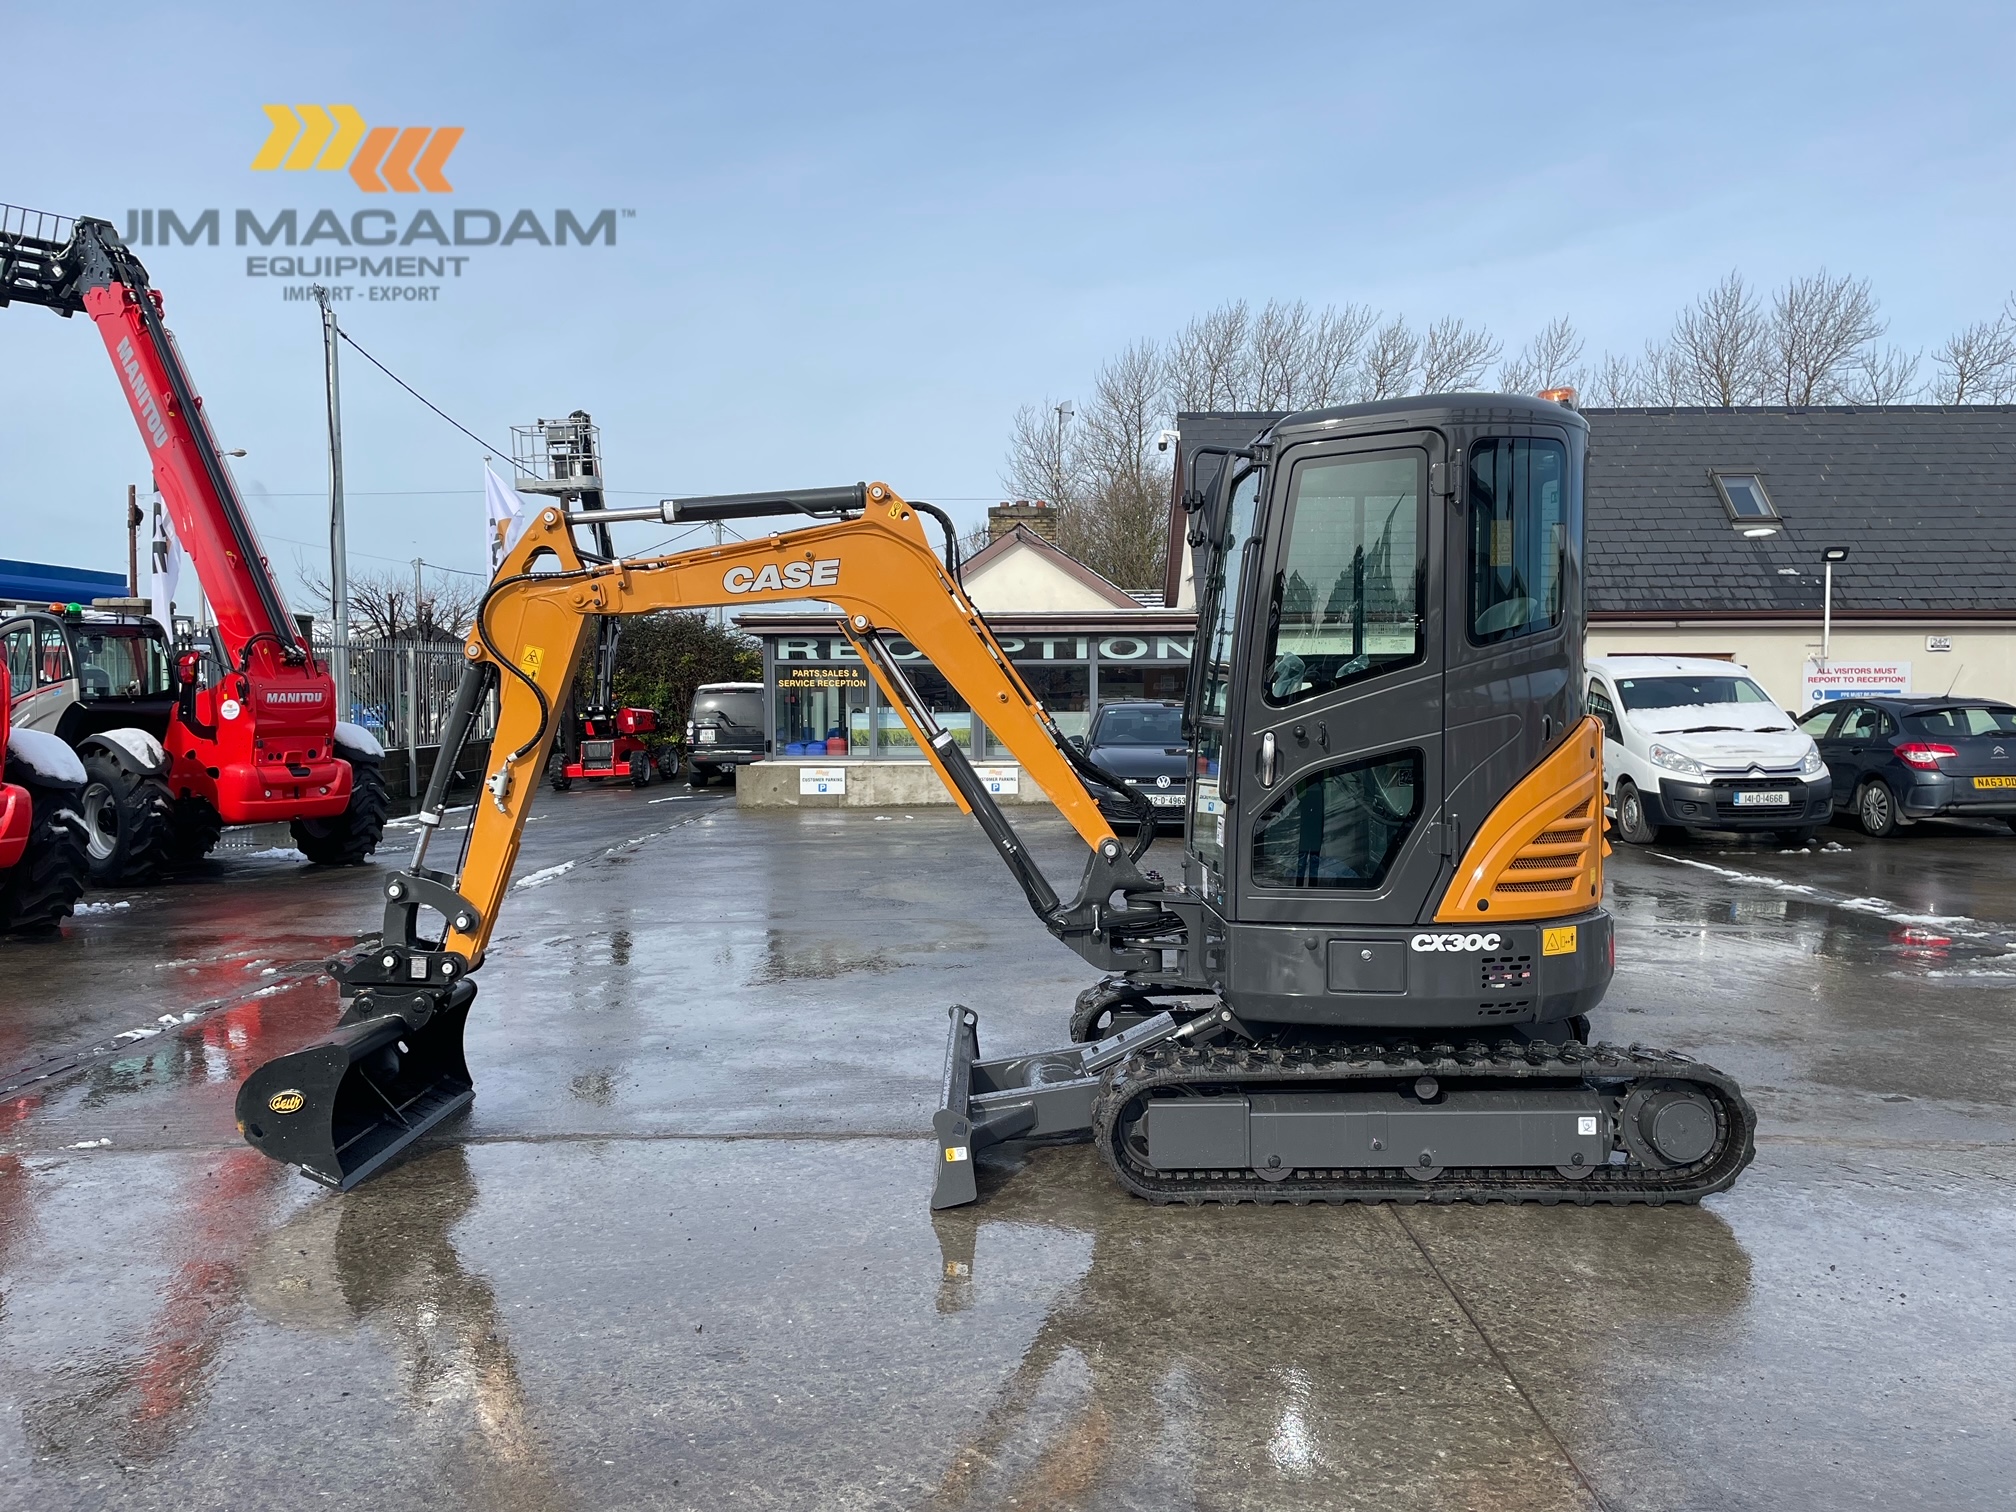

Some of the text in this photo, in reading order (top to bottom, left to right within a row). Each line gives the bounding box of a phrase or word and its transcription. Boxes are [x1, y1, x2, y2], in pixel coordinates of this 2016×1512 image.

[116, 335, 169, 449] MANITOU
[722, 558, 841, 595] CASE
[777, 636, 1194, 660] RECPTION
[851, 669, 859, 678] &
[1816, 667, 1898, 675] ALL VISITORS MUST
[778, 679, 867, 688] SERVICE RECEPTION
[1807, 676, 1906, 684] REPORT TO RECEPTION!
[266, 692, 323, 704] MANITOU
[1977, 777, 2004, 787] NA63
[1411, 932, 1502, 953] CX30C
